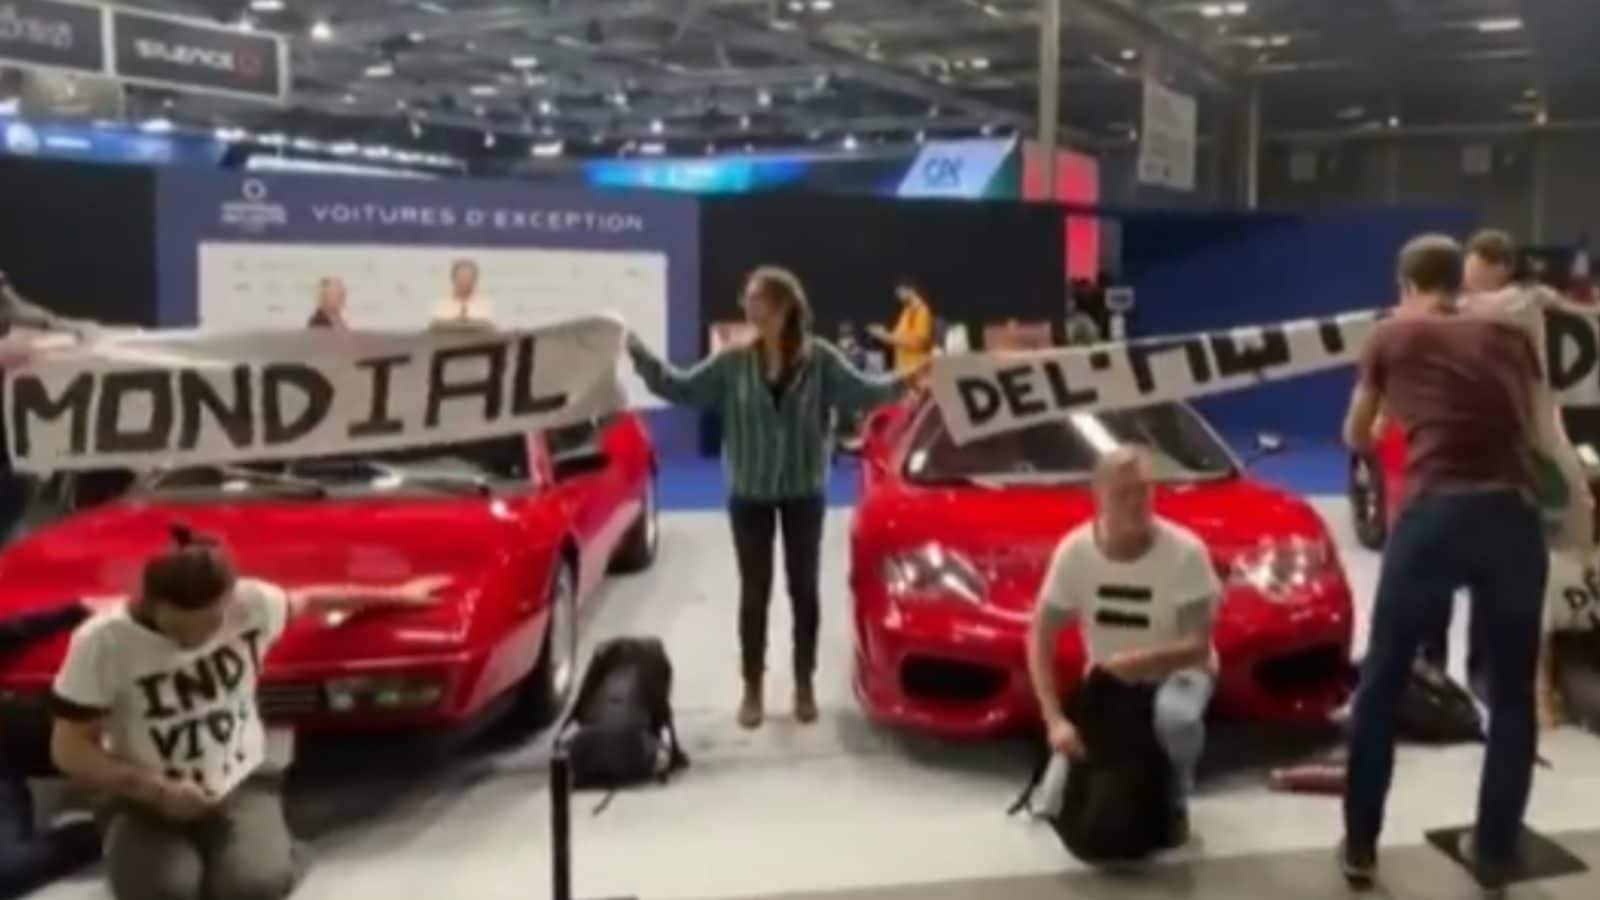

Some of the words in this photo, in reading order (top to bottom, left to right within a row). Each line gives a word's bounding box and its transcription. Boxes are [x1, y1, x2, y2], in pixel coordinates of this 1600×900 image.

[312, 202, 456, 228] VOITURES
[465, 208, 645, 233] D'EXCEPTION
[12, 336, 568, 456] MONDIAL
